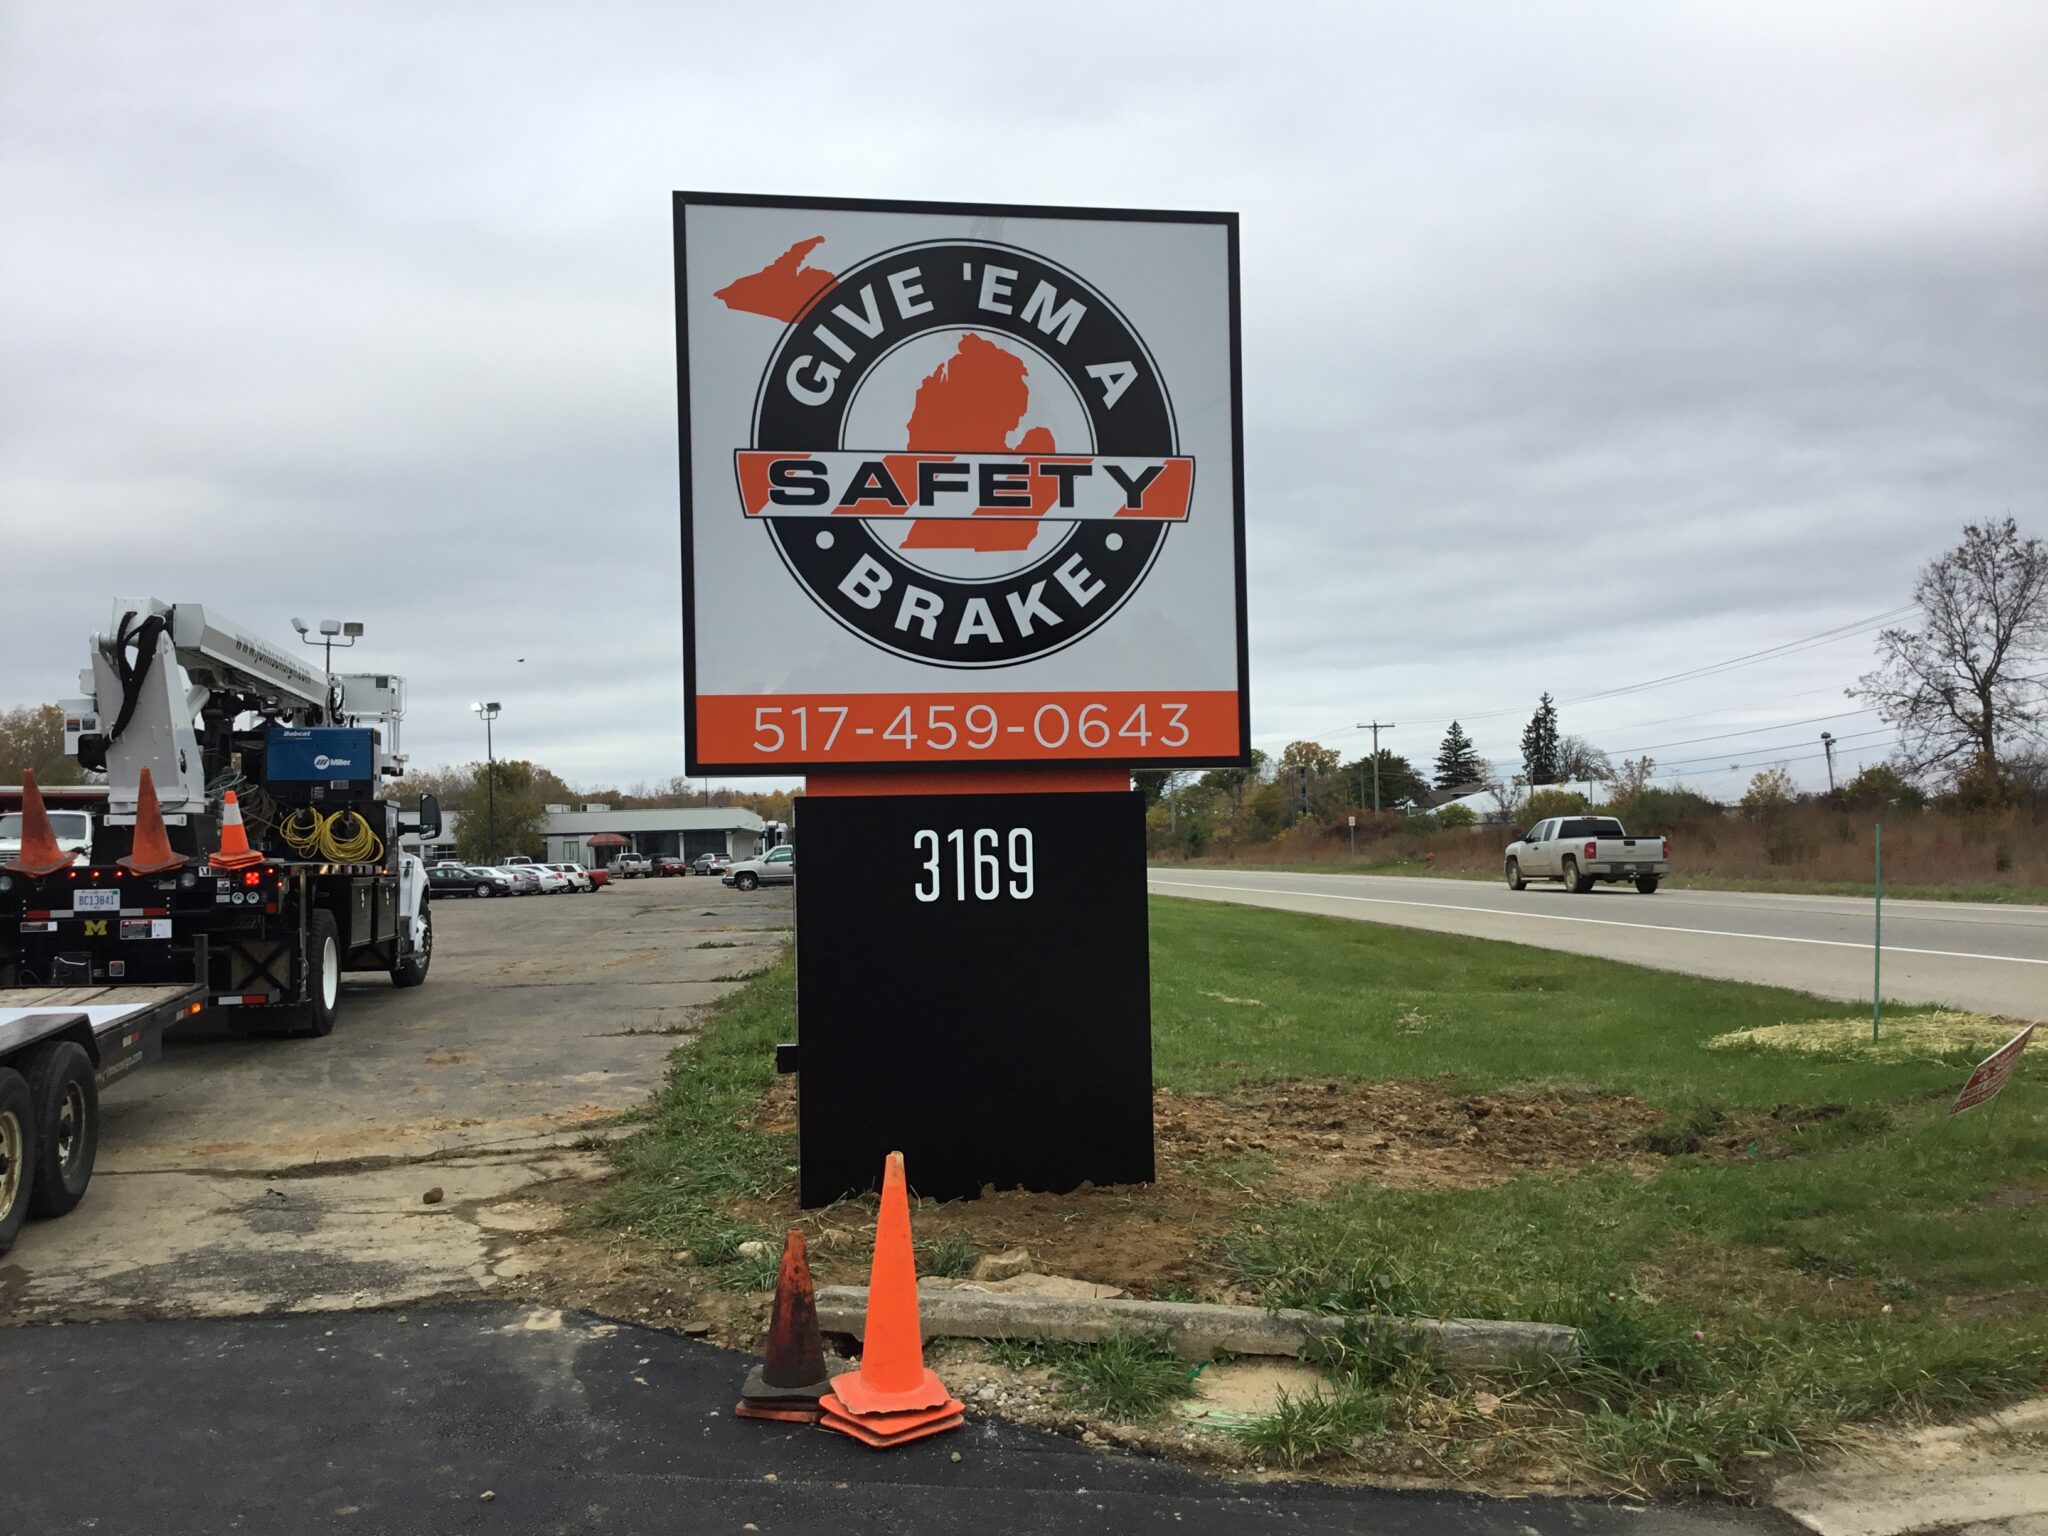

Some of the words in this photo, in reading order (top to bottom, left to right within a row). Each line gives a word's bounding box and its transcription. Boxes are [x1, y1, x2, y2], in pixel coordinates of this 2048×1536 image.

[786, 266, 934, 406] GIVE
[963, 262, 1087, 345] 'EM
[1085, 361, 1138, 410] A
[768, 459, 1166, 510] SAFETY
[837, 552, 1106, 644] BRAKE
[753, 703, 1190, 752] 517-459-0643
[330, 758, 352, 766] Miller
[914, 827, 1034, 902] 3169
[84, 919, 107, 936] M
